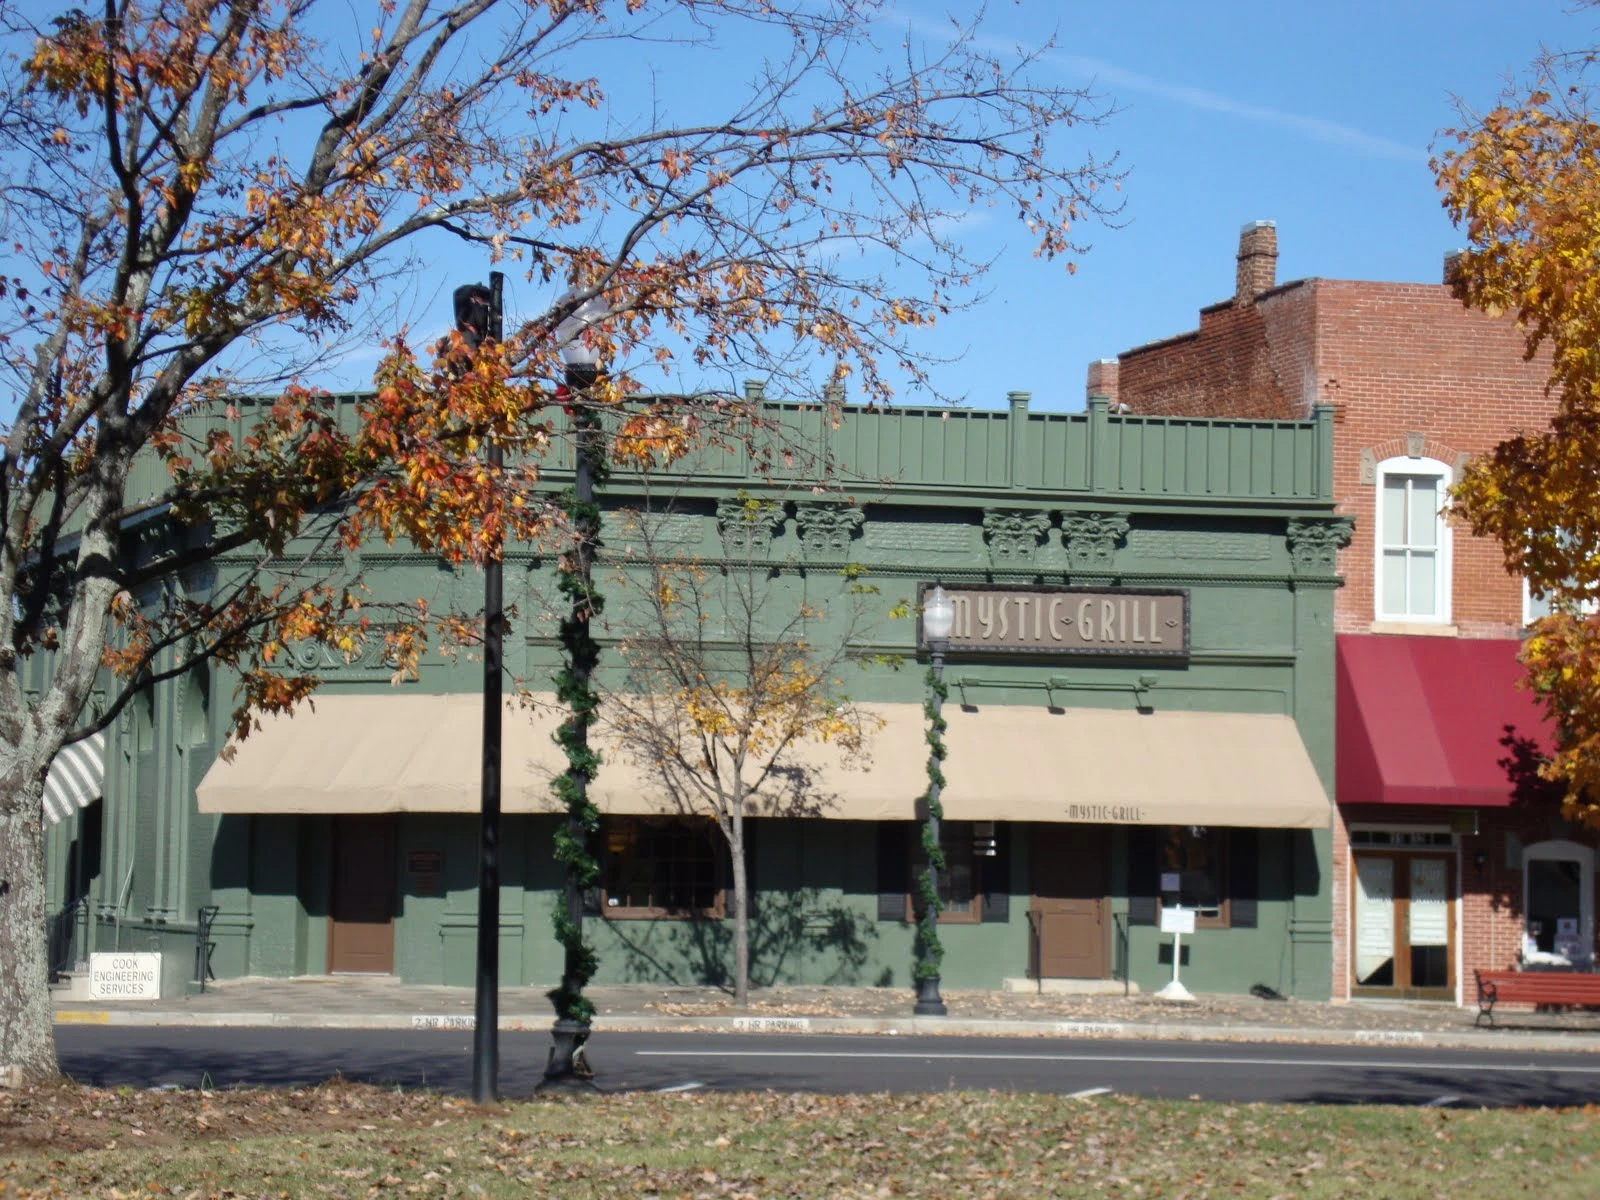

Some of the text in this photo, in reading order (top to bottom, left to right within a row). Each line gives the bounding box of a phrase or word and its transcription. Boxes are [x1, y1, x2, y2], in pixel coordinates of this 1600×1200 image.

[948, 595, 1163, 643] MYSTIC GRILL
[1069, 804, 1141, 821] MYSTIC GRILL
[112, 958, 139, 969] COOK
[94, 971, 154, 982] ENGINEERING
[100, 983, 144, 994] SERVICES
[443, 1016, 476, 1027] PARKIN
